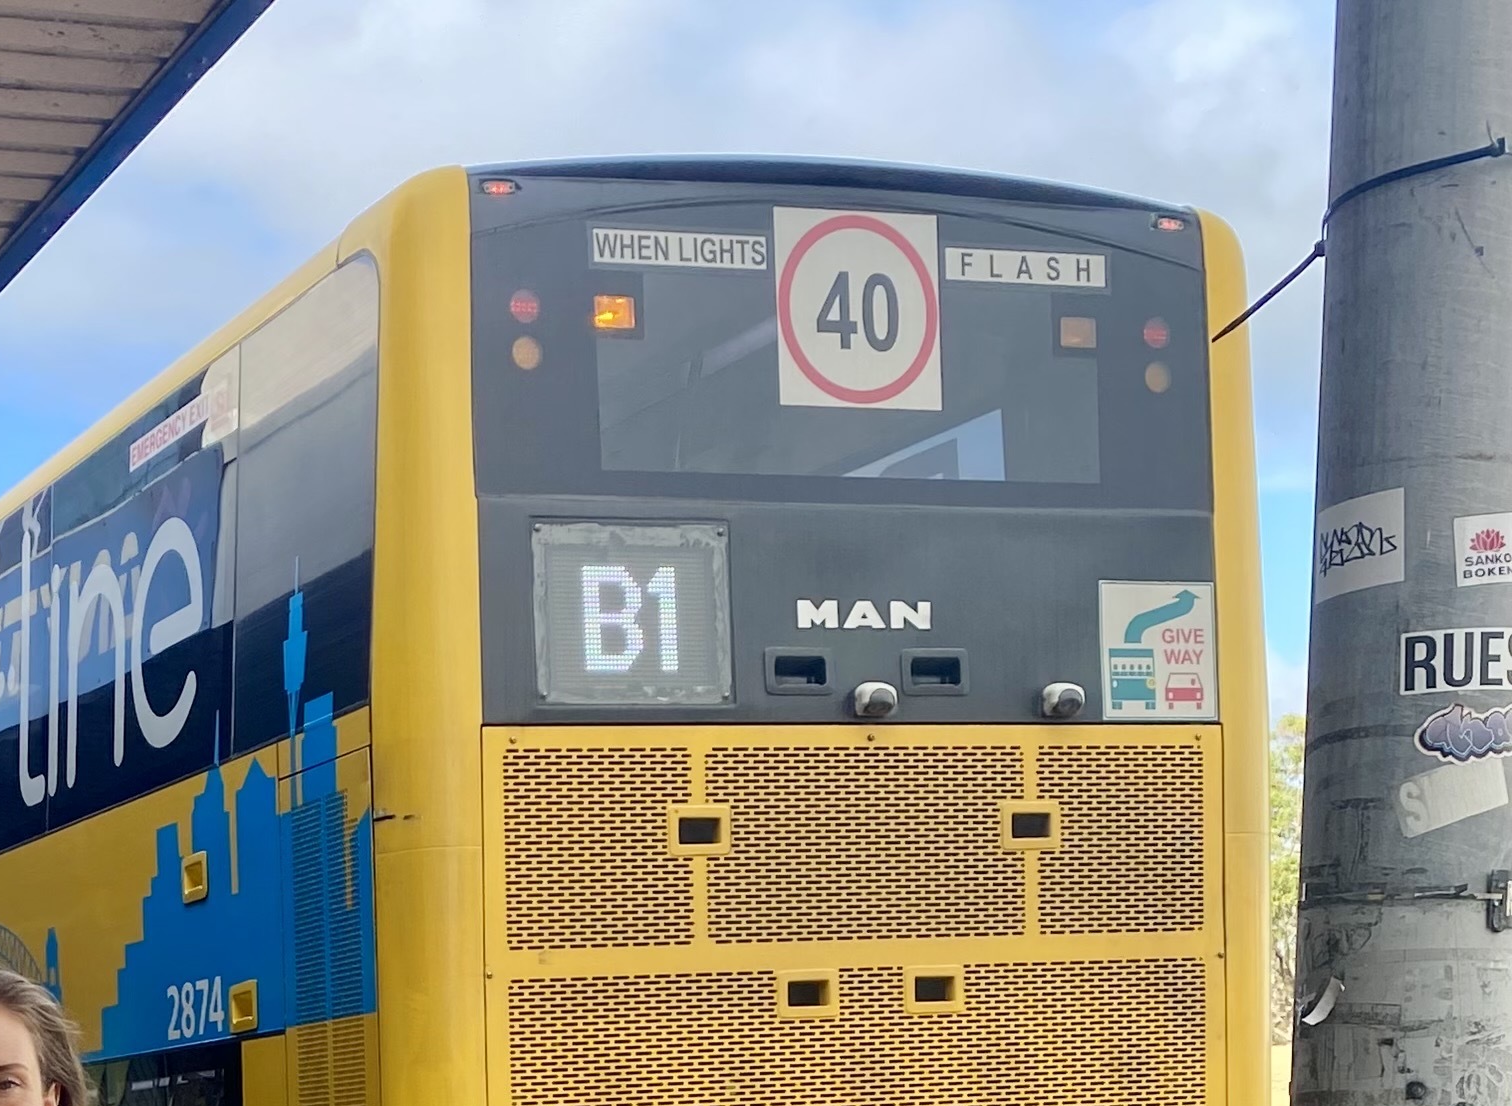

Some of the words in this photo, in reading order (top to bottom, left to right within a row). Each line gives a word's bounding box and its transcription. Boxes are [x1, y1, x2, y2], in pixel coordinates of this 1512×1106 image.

[595, 232, 670, 262] WHEN
[678, 236, 766, 266] LIGHTS
[961, 252, 1091, 284] FLASH
[816, 270, 899, 353] 40
[131, 412, 188, 467] EMERGENCY
[581, 565, 679, 671] B1
[796, 598, 932, 631] MAN
[1162, 628, 1205, 645] GIVE
[1164, 648, 1204, 665] WAY
[1404, 631, 1512, 692] RUE
[167, 975, 224, 1040] 2874
